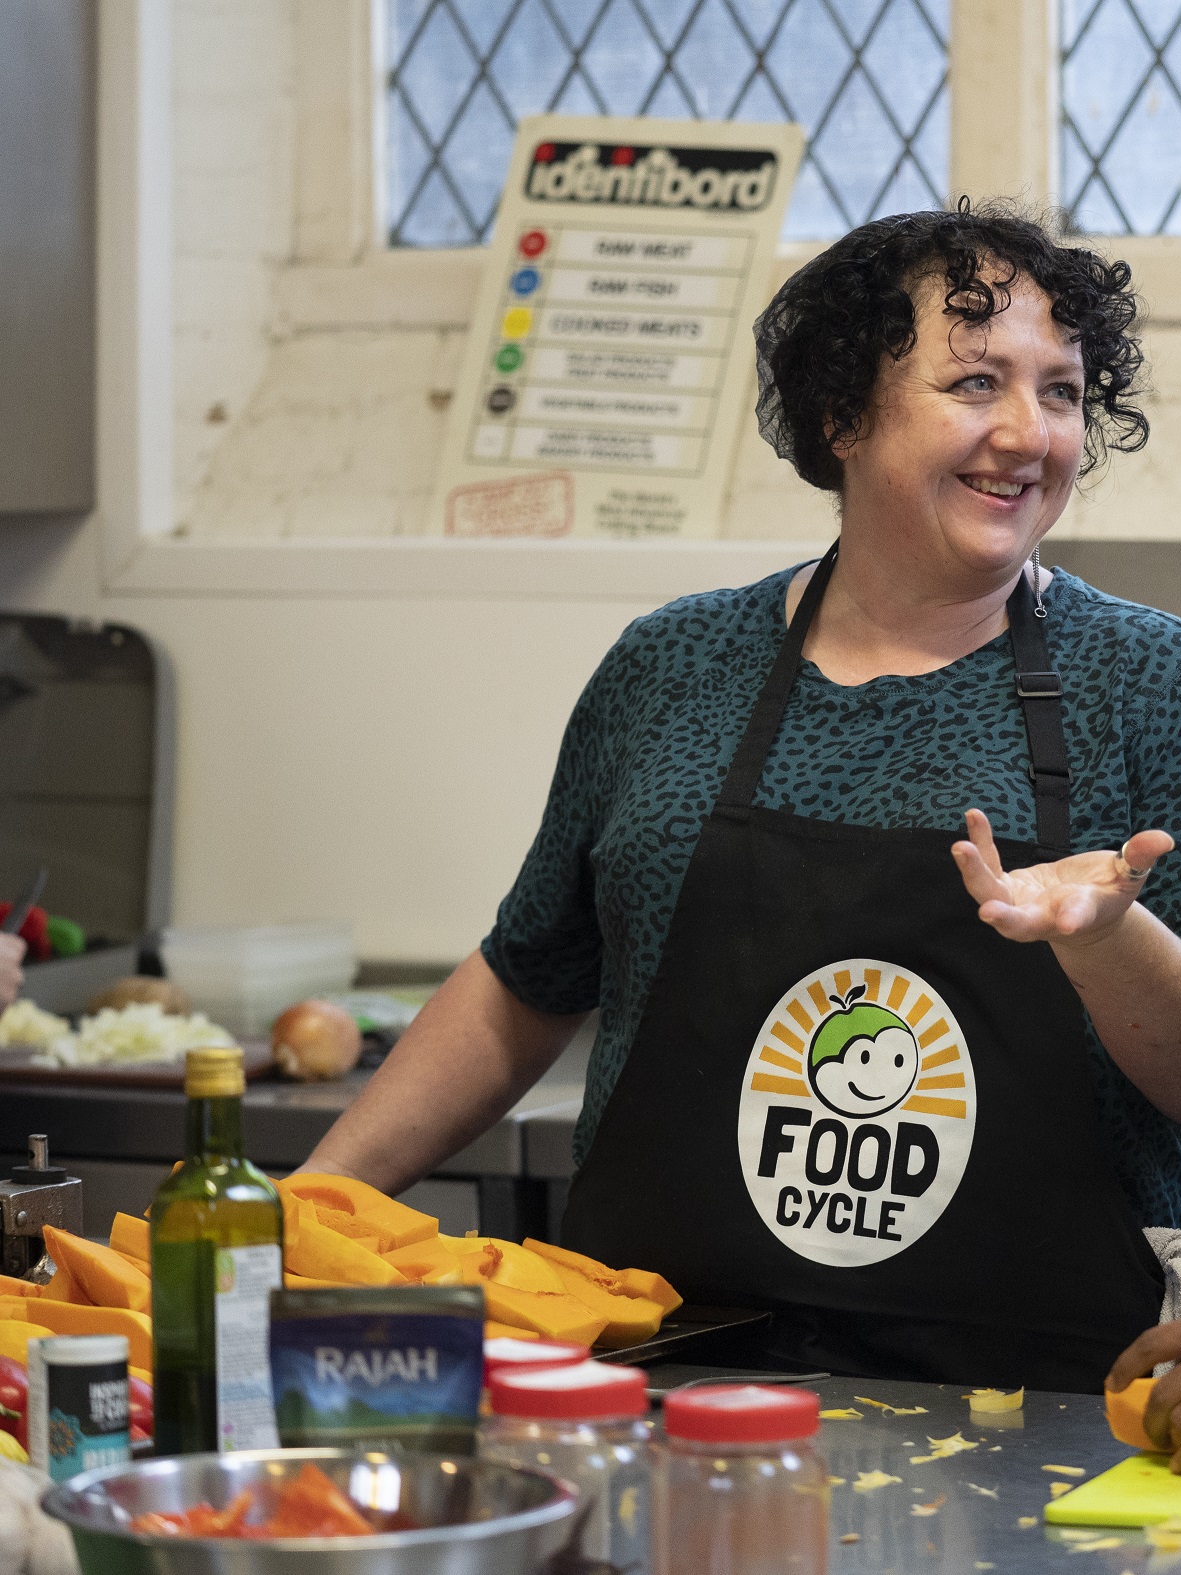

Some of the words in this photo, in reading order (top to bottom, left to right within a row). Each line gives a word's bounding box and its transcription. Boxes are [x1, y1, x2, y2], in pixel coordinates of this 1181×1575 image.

[757, 1105, 940, 1198] FOOD
[776, 1185, 906, 1242] CYCLE
[314, 1345, 440, 1383] RAJAH
